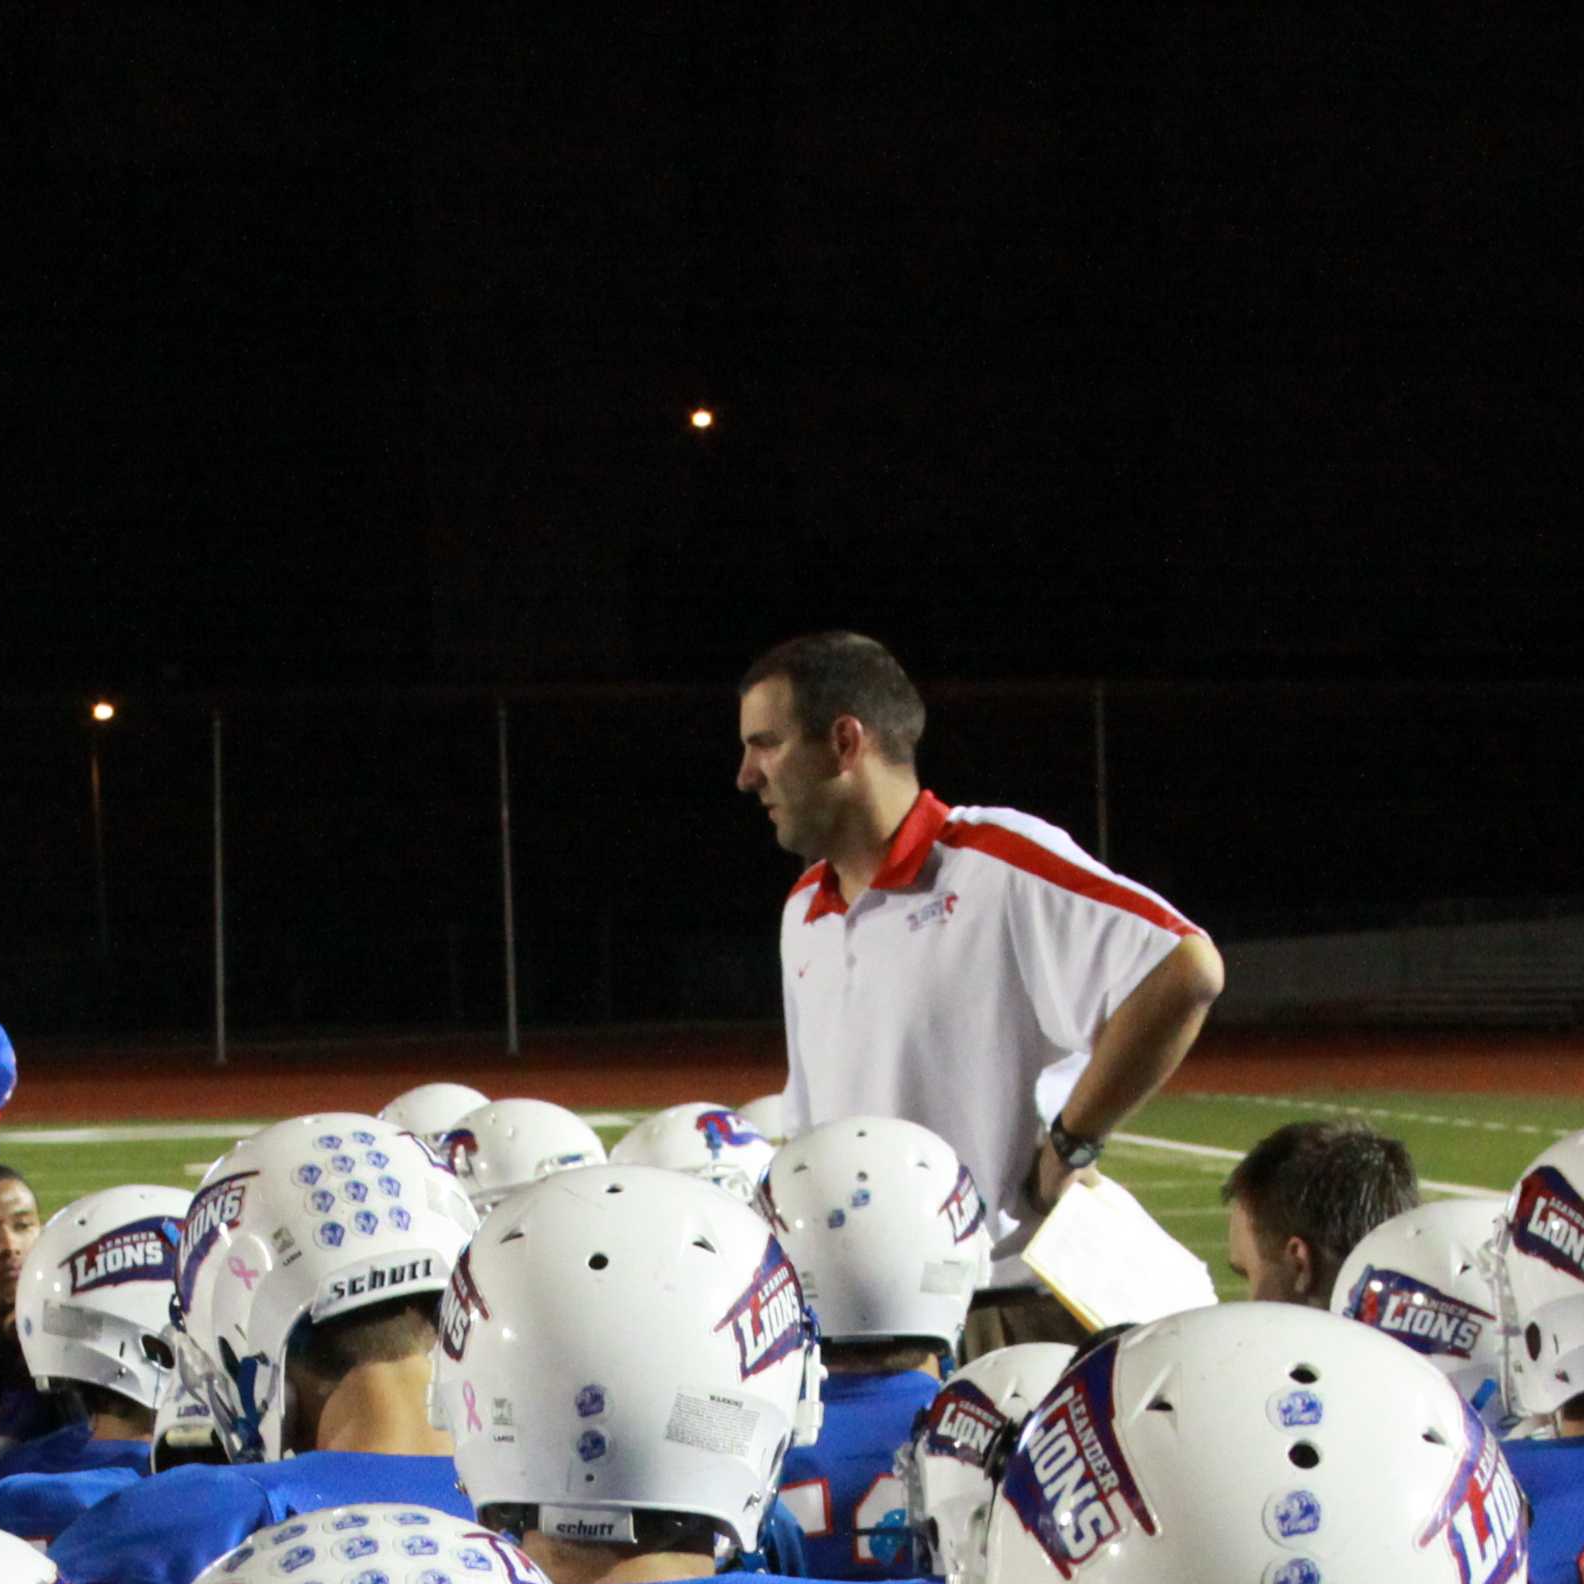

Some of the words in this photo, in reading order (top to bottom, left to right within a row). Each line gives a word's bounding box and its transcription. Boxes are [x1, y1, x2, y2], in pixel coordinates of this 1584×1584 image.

[75, 1240, 164, 1288] LIONS
[98, 1231, 158, 1253] LEANDER
[738, 1283, 800, 1365] LIONS
[1379, 1293, 1482, 1353] LIONS
[937, 1402, 995, 1455] LION
[1068, 1390, 1119, 1496] LEANDER
[1034, 1388, 1117, 1563] LIONS
